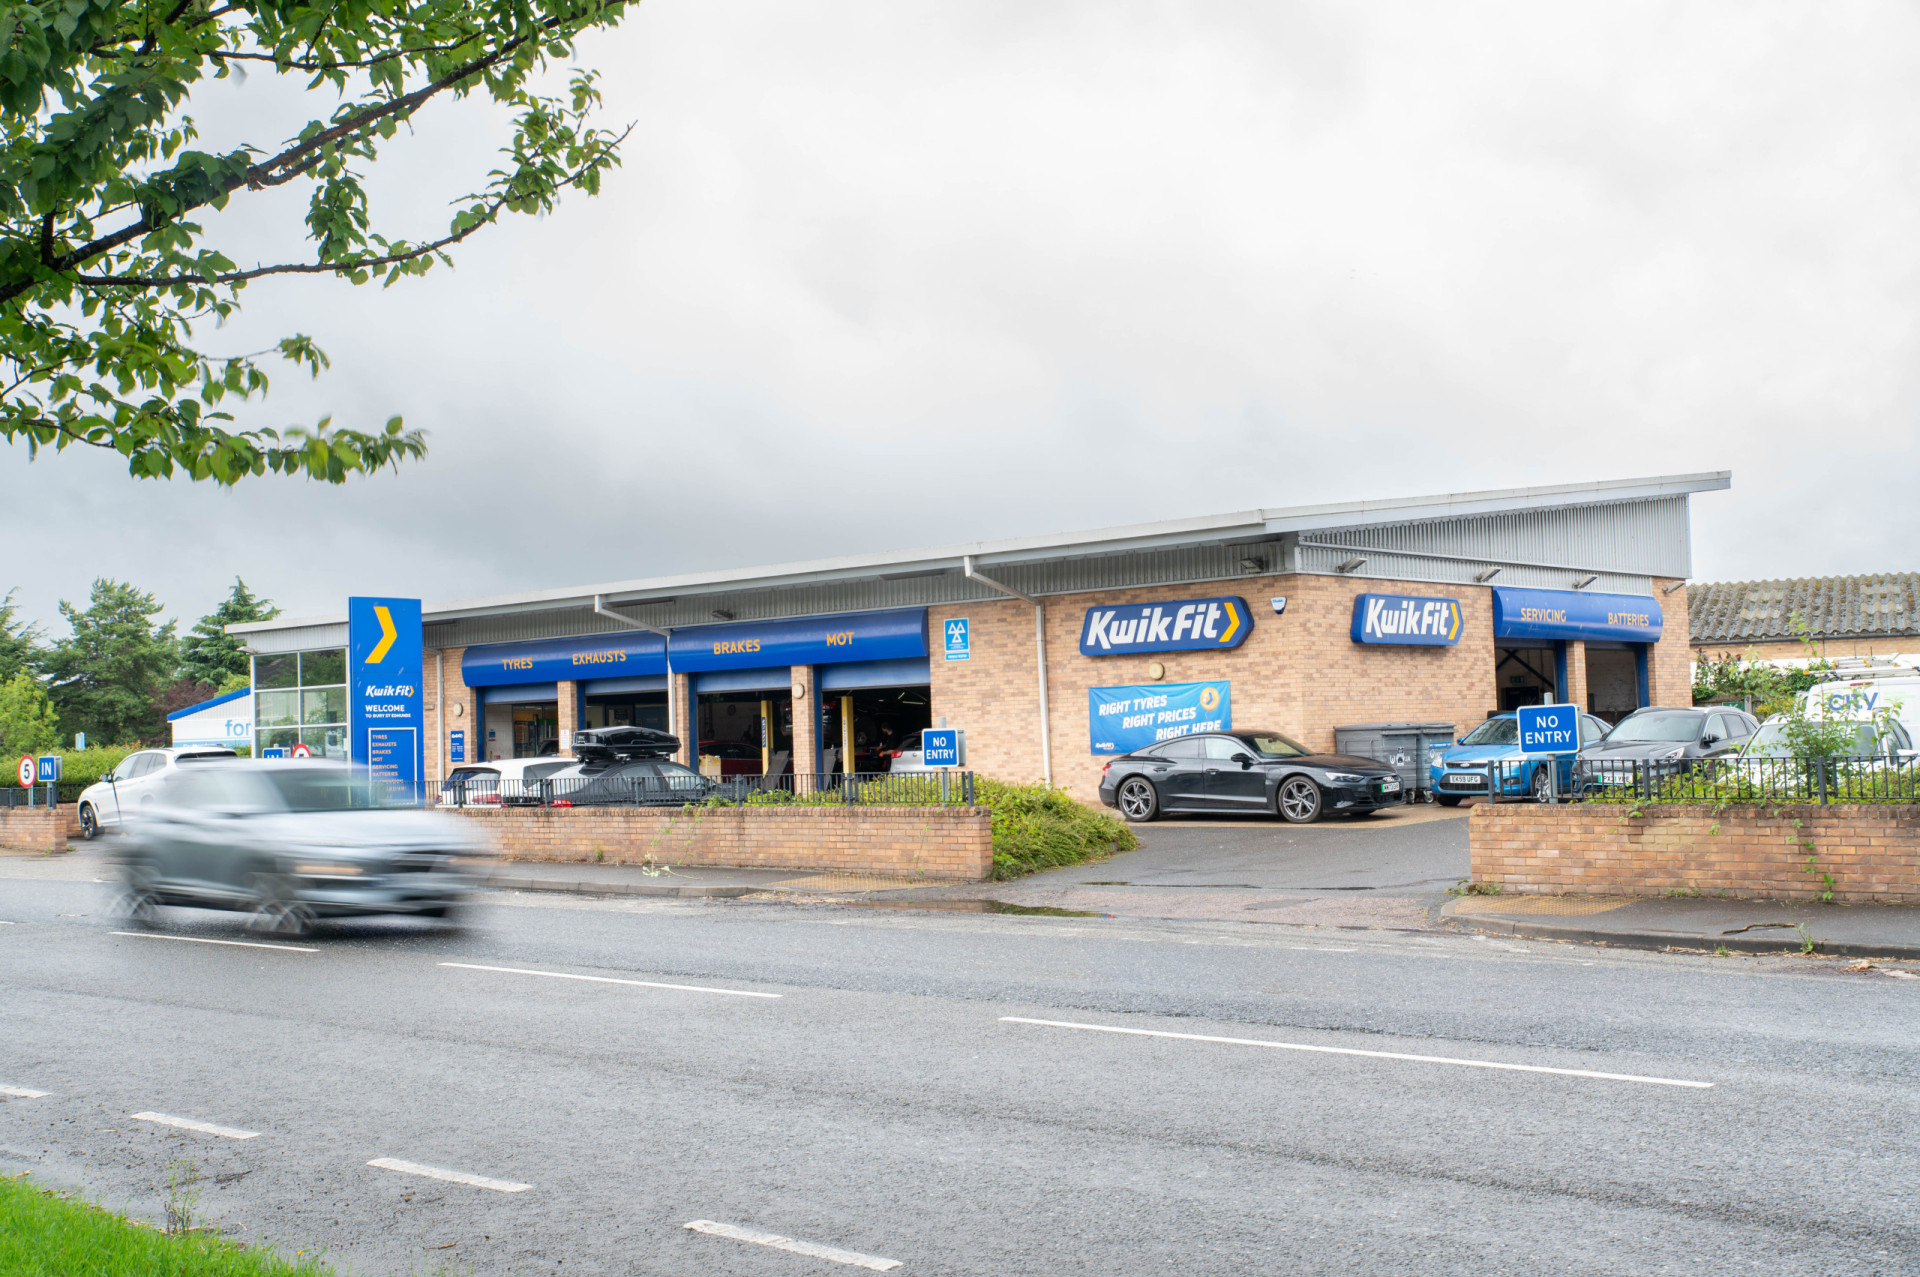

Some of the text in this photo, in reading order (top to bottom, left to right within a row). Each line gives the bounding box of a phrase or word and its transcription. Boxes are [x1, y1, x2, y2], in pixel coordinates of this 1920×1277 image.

[1520, 608, 1567, 623] SERVICING
[1608, 612, 1649, 626] BATTERIES
[826, 632, 855, 647] MOT
[713, 639, 761, 655] BRAKES
[502, 657, 533, 670] TYRES
[572, 649, 626, 665] EXHAUSTS
[365, 704, 405, 712] WELCOME
[1098, 695, 1167, 716] RIGHT TYRES
[1122, 707, 1197, 729] RIGHT PRICES
[1536, 715, 1559, 728] NO
[1155, 724, 1190, 740] RIGHT
[1525, 730, 1571, 744] ENTRY
[932, 736, 947, 747] NO
[926, 749, 954, 760] ENTRY
[24, 763, 30, 779] 5
[41, 762, 52, 776] IN
